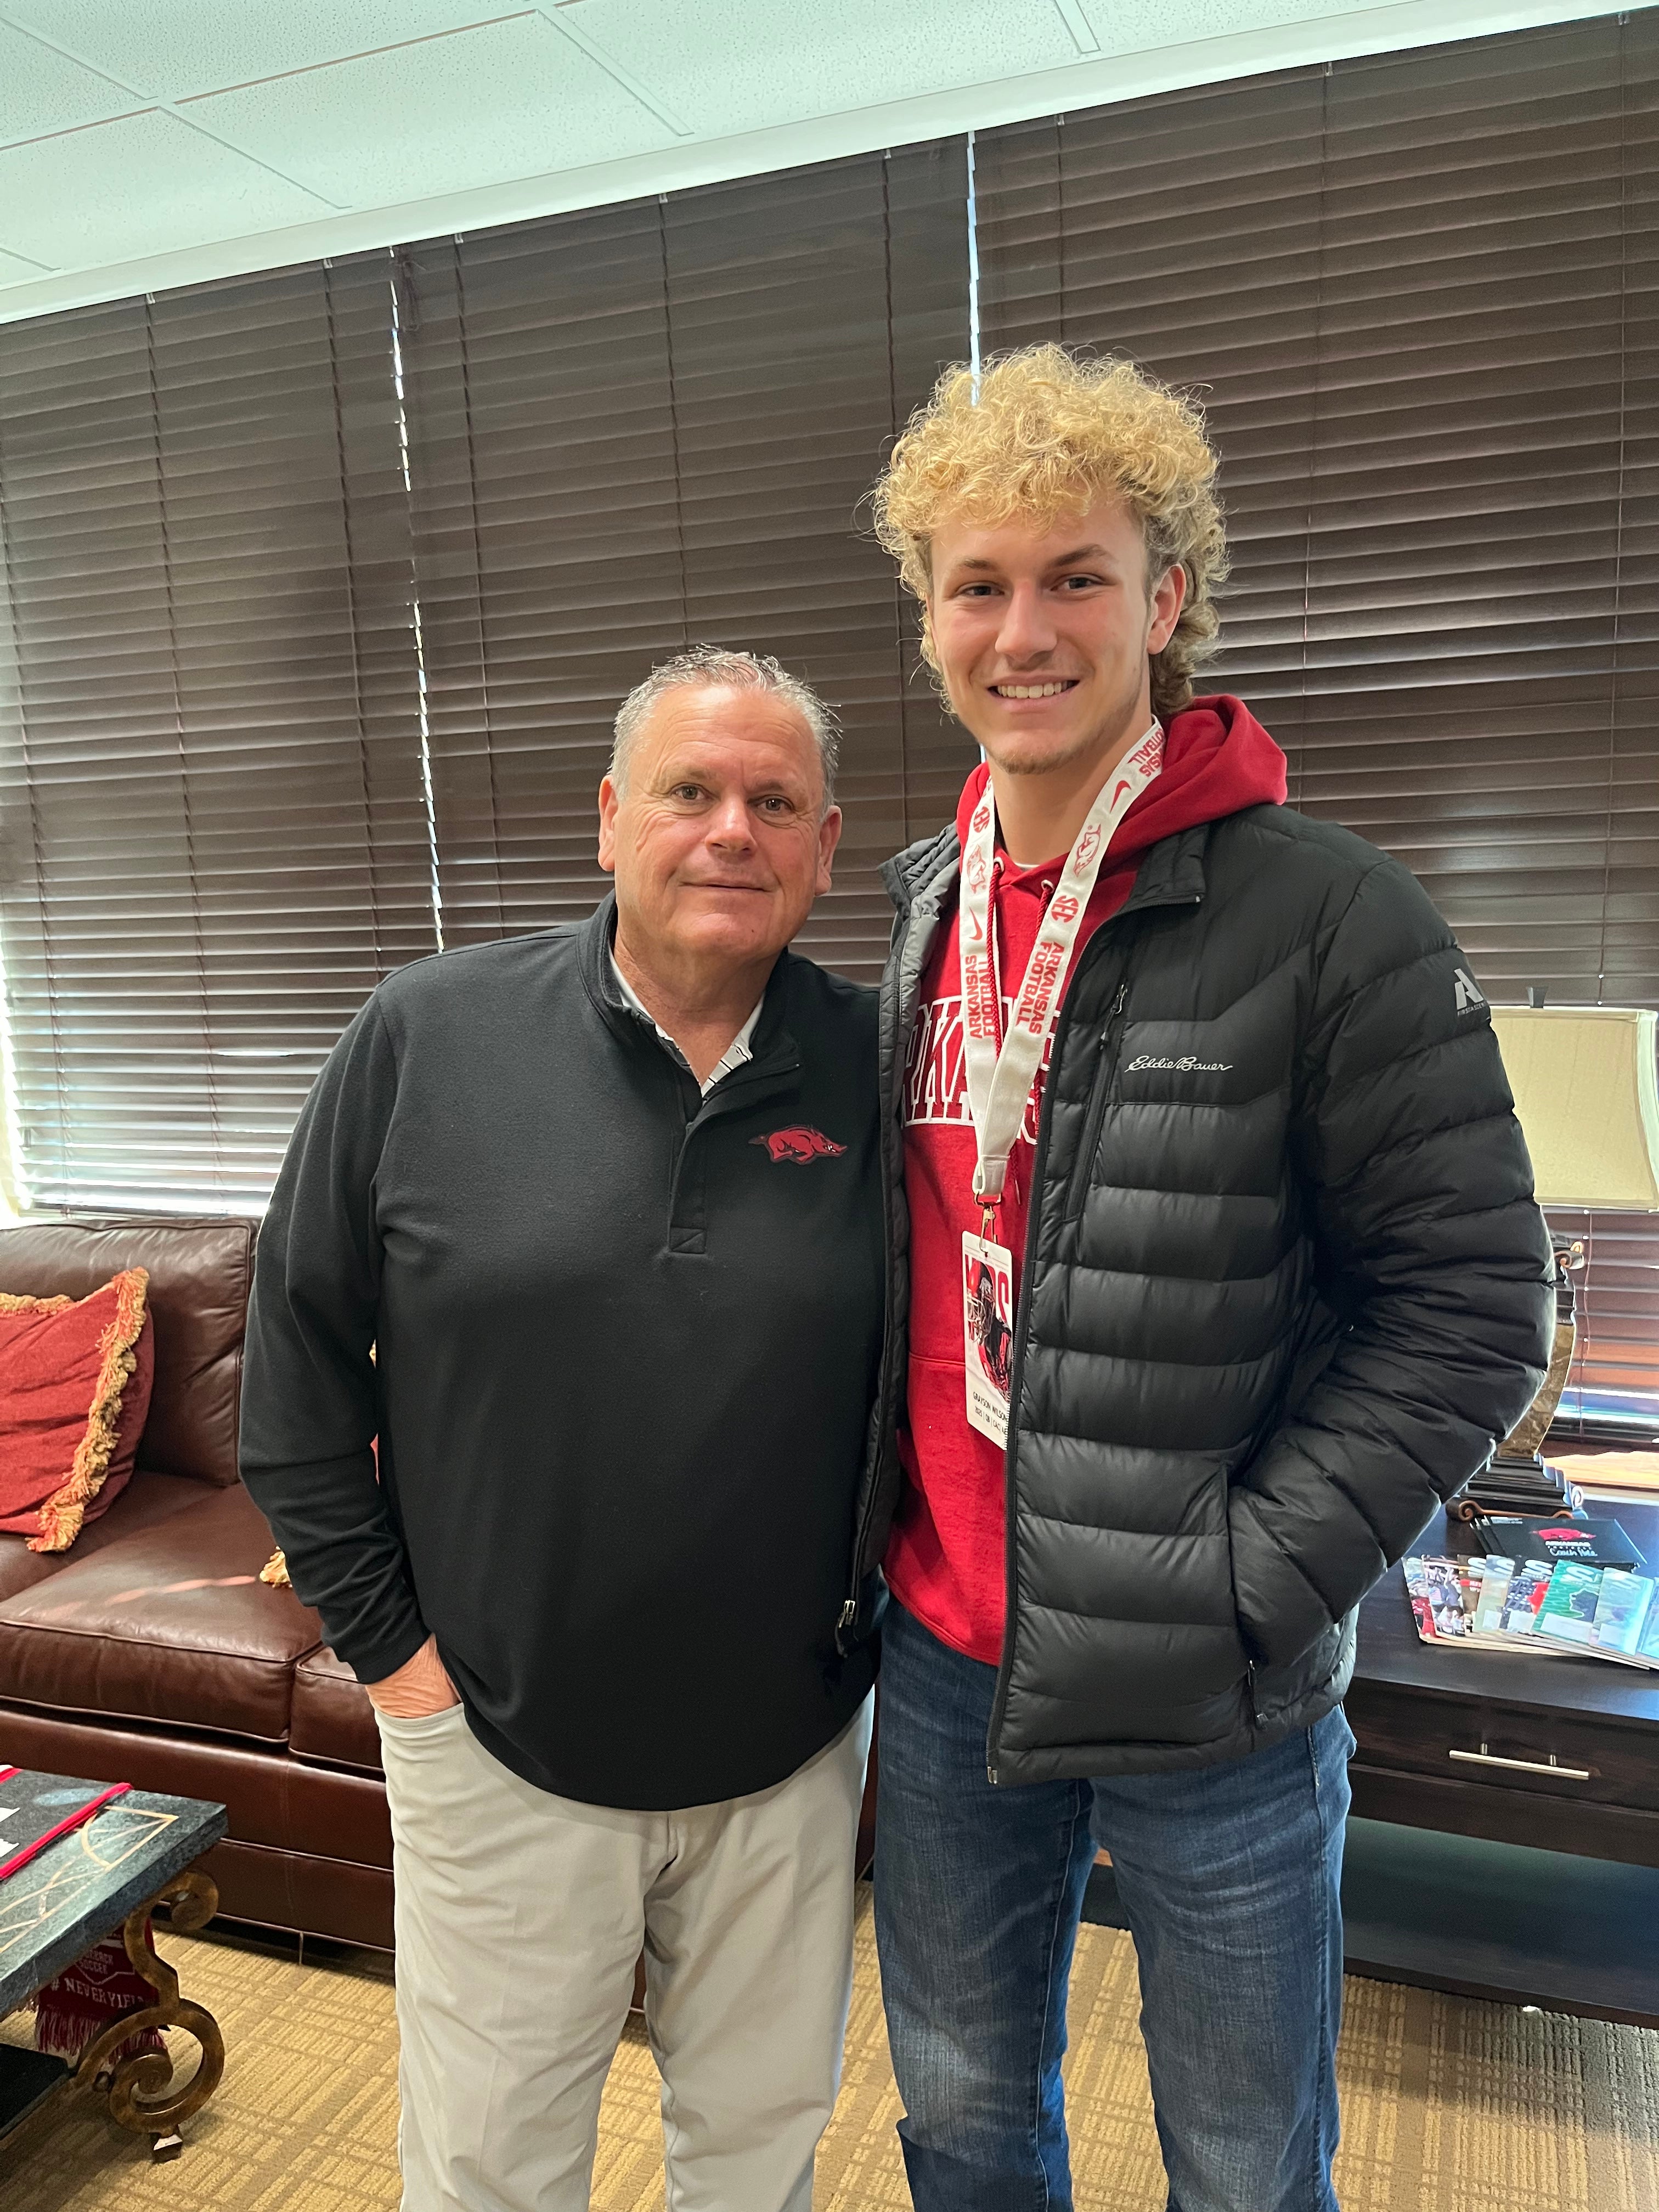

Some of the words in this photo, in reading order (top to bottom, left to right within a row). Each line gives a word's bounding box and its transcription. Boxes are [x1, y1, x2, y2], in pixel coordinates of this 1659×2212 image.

[1051, 895, 1079, 923] SEC
[965, 955, 983, 1039] ARKANSAS
[1015, 941, 1053, 1026] FOOTBALL
[1029, 941, 1065, 1035] ARKANSAS
[1125, 1056, 1177, 1073] Eddie
[1176, 1057, 1234, 1071] Bauer
